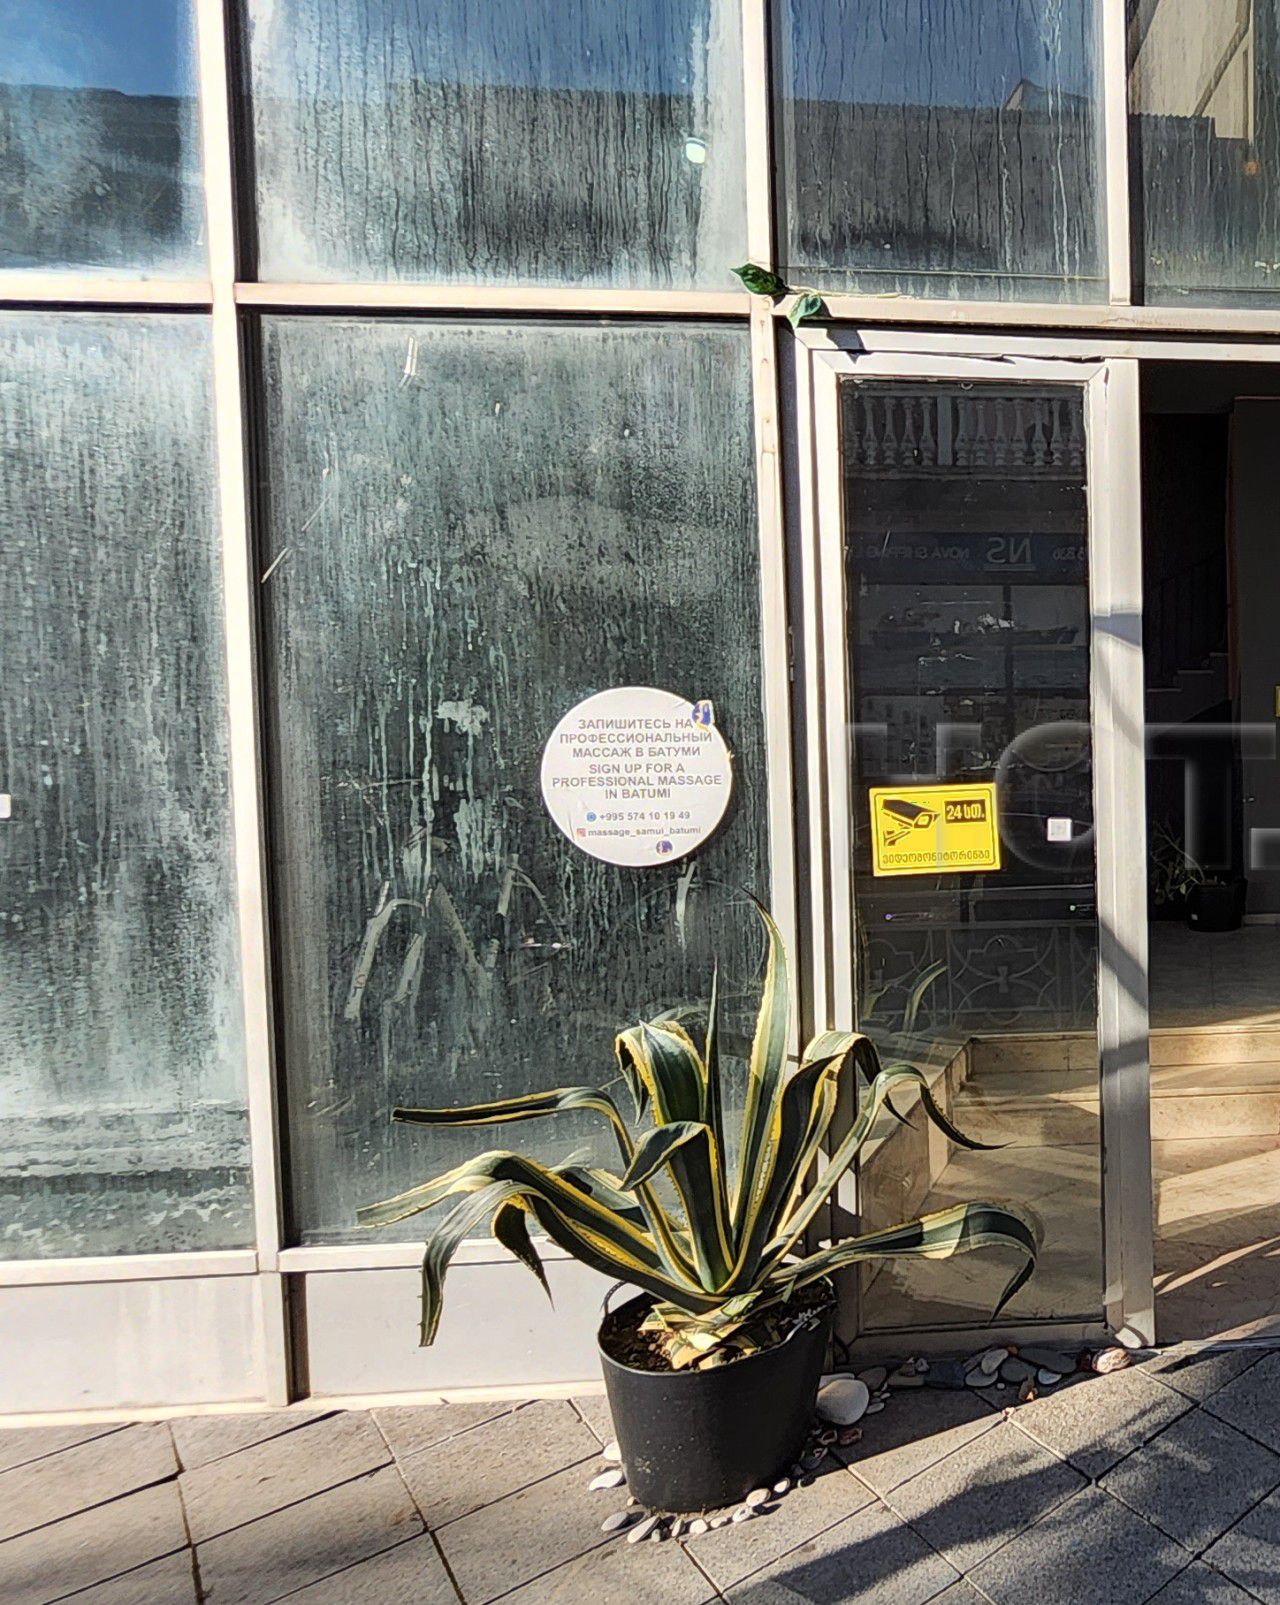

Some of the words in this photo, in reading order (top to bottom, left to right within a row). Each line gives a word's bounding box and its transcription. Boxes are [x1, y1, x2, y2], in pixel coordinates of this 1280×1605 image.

[578, 719, 671, 730] ЗАПИШИТЕСЬ
[675, 719, 693, 729] НА
[560, 732, 712, 744] ПРОФЕССИОНАЛЬНЫЙ
[572, 747, 632, 758] МАССАЖ
[635, 747, 644, 757] В
[648, 747, 700, 757] БАТУМИ
[589, 764, 621, 774] SIGN
[624, 764, 642, 774] UP
[646, 763, 673, 773] FOR
[676, 763, 685, 773] A
[552, 776, 655, 787] PROFESSIONAL
[658, 775, 722, 786] MASSAGE
[605, 789, 617, 799] IN
[621, 788, 671, 799] BATUMI
[600, 812, 625, 821] +995
[627, 811, 645, 821] 574
[649, 811, 661, 820] 10
[664, 811, 675, 820] 19
[678, 811, 690, 820] 49
[946, 804, 962, 820] 24
